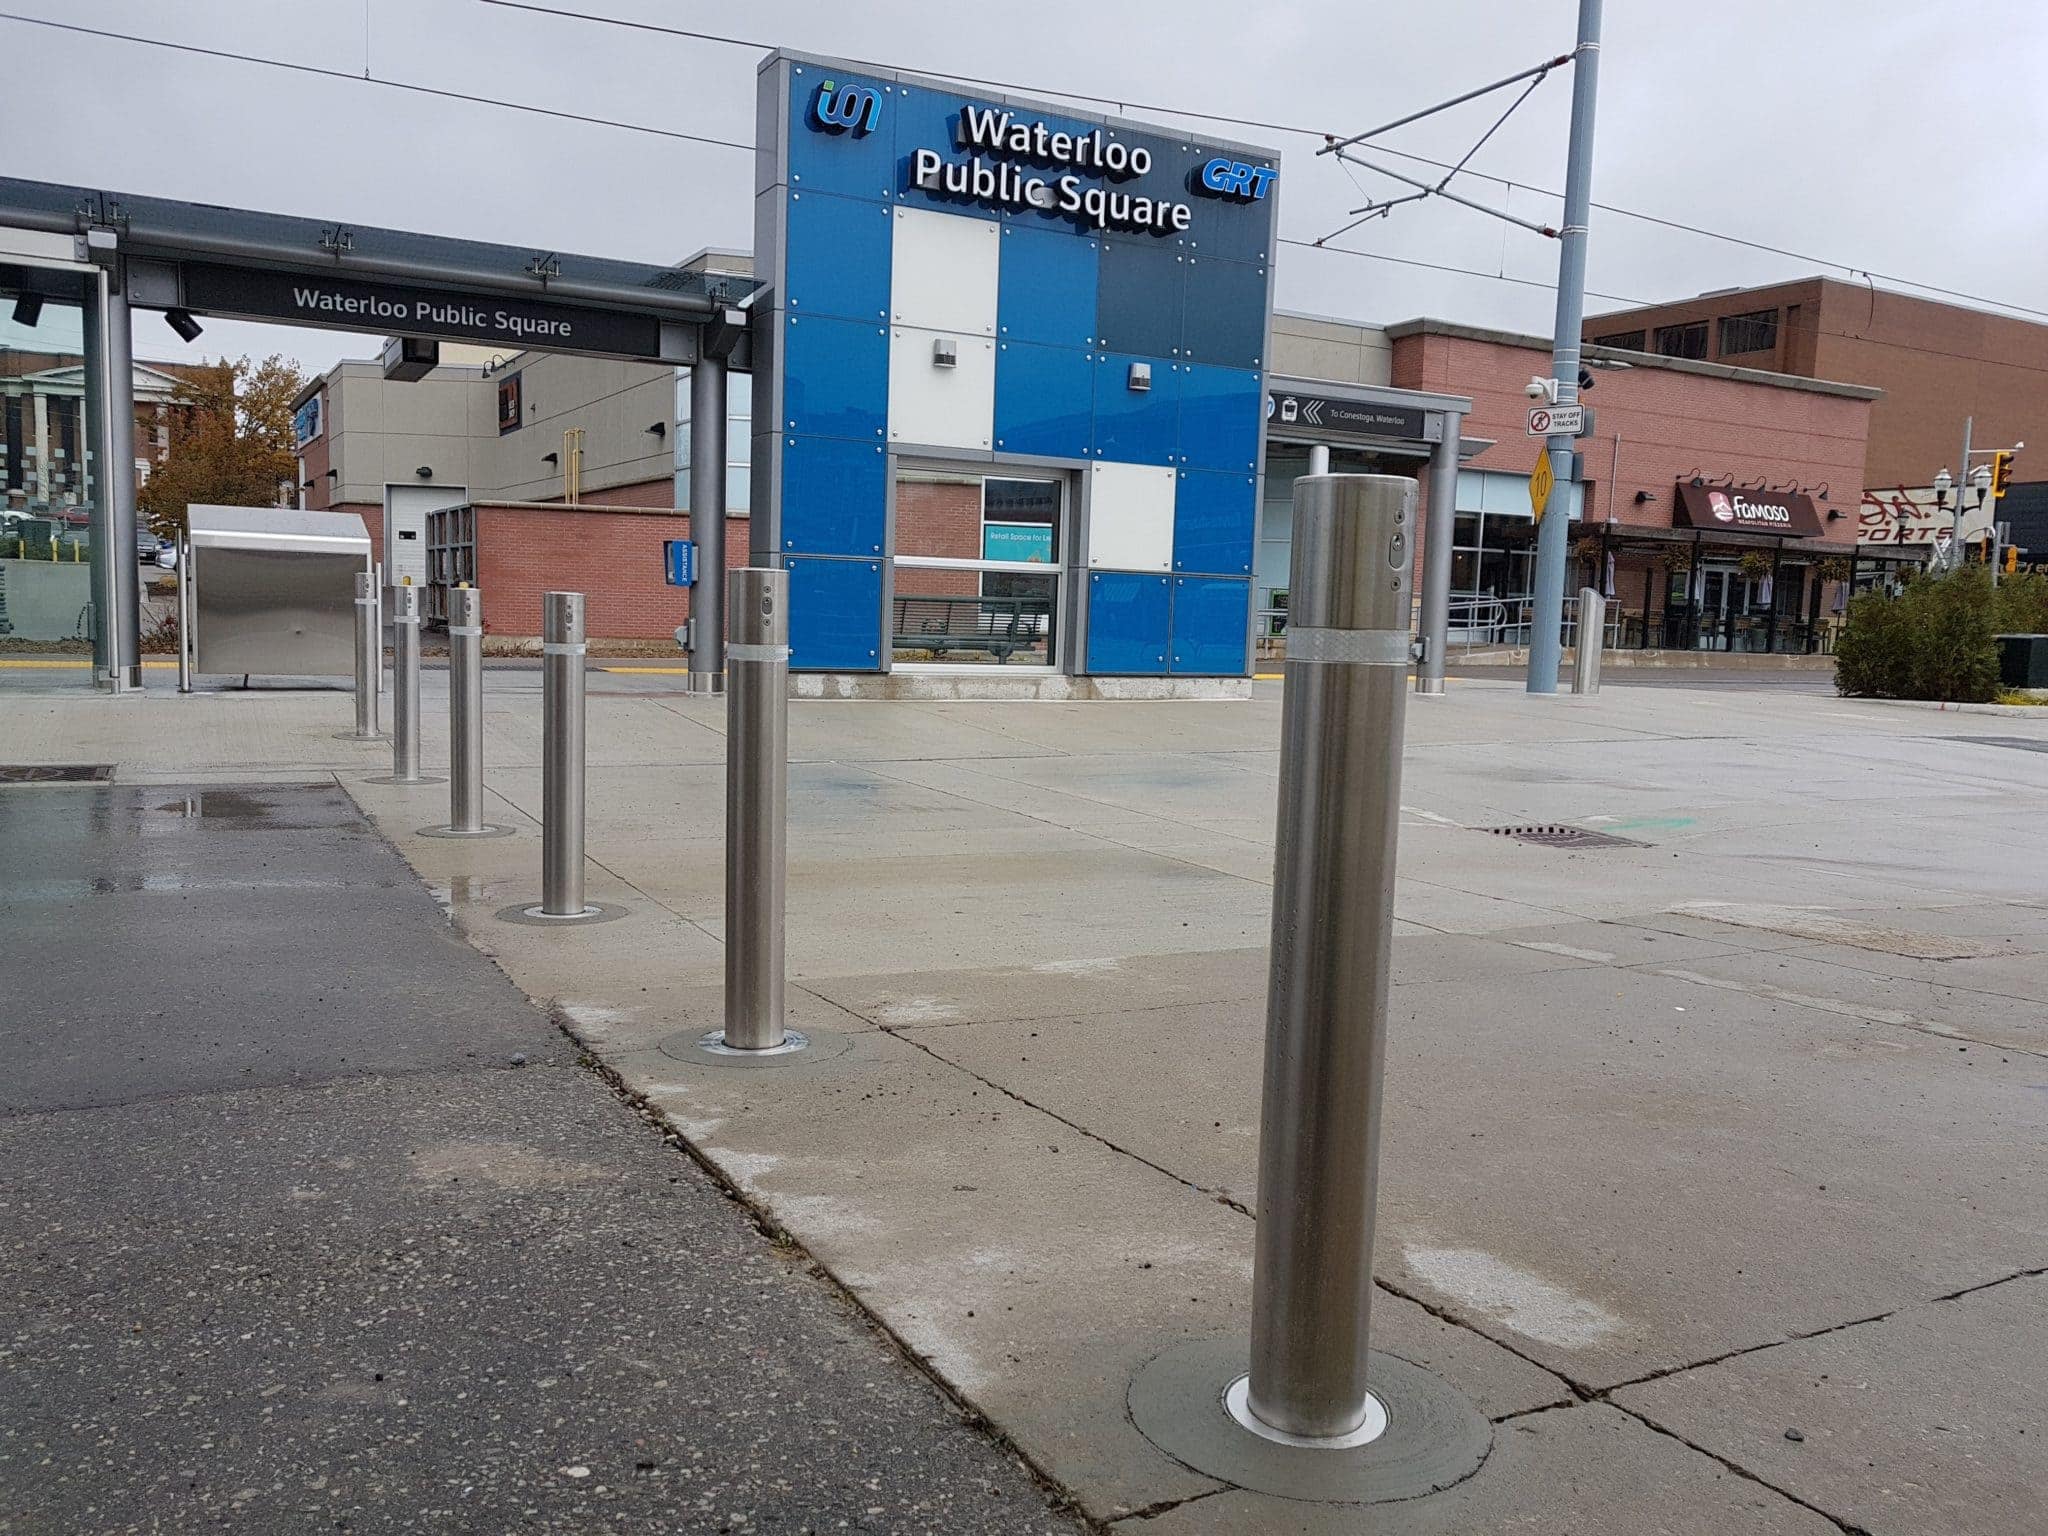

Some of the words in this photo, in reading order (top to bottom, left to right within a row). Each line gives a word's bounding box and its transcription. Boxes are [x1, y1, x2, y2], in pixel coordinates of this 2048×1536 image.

[966, 105, 1152, 175] Waterloo
[915, 149, 1045, 207] Public
[1057, 175, 1192, 231] Square
[1202, 158, 1279, 199] GRT
[293, 287, 408, 319] Waterloo
[415, 302, 488, 327] Public
[494, 311, 572, 337] Square
[1331, 409, 1339, 418] To
[1339, 410, 1375, 423] Conestoga,
[1376, 415, 1405, 425] Waterloo
[1568, 411, 1580, 419] OFF
[1535, 471, 1547, 497] 10
